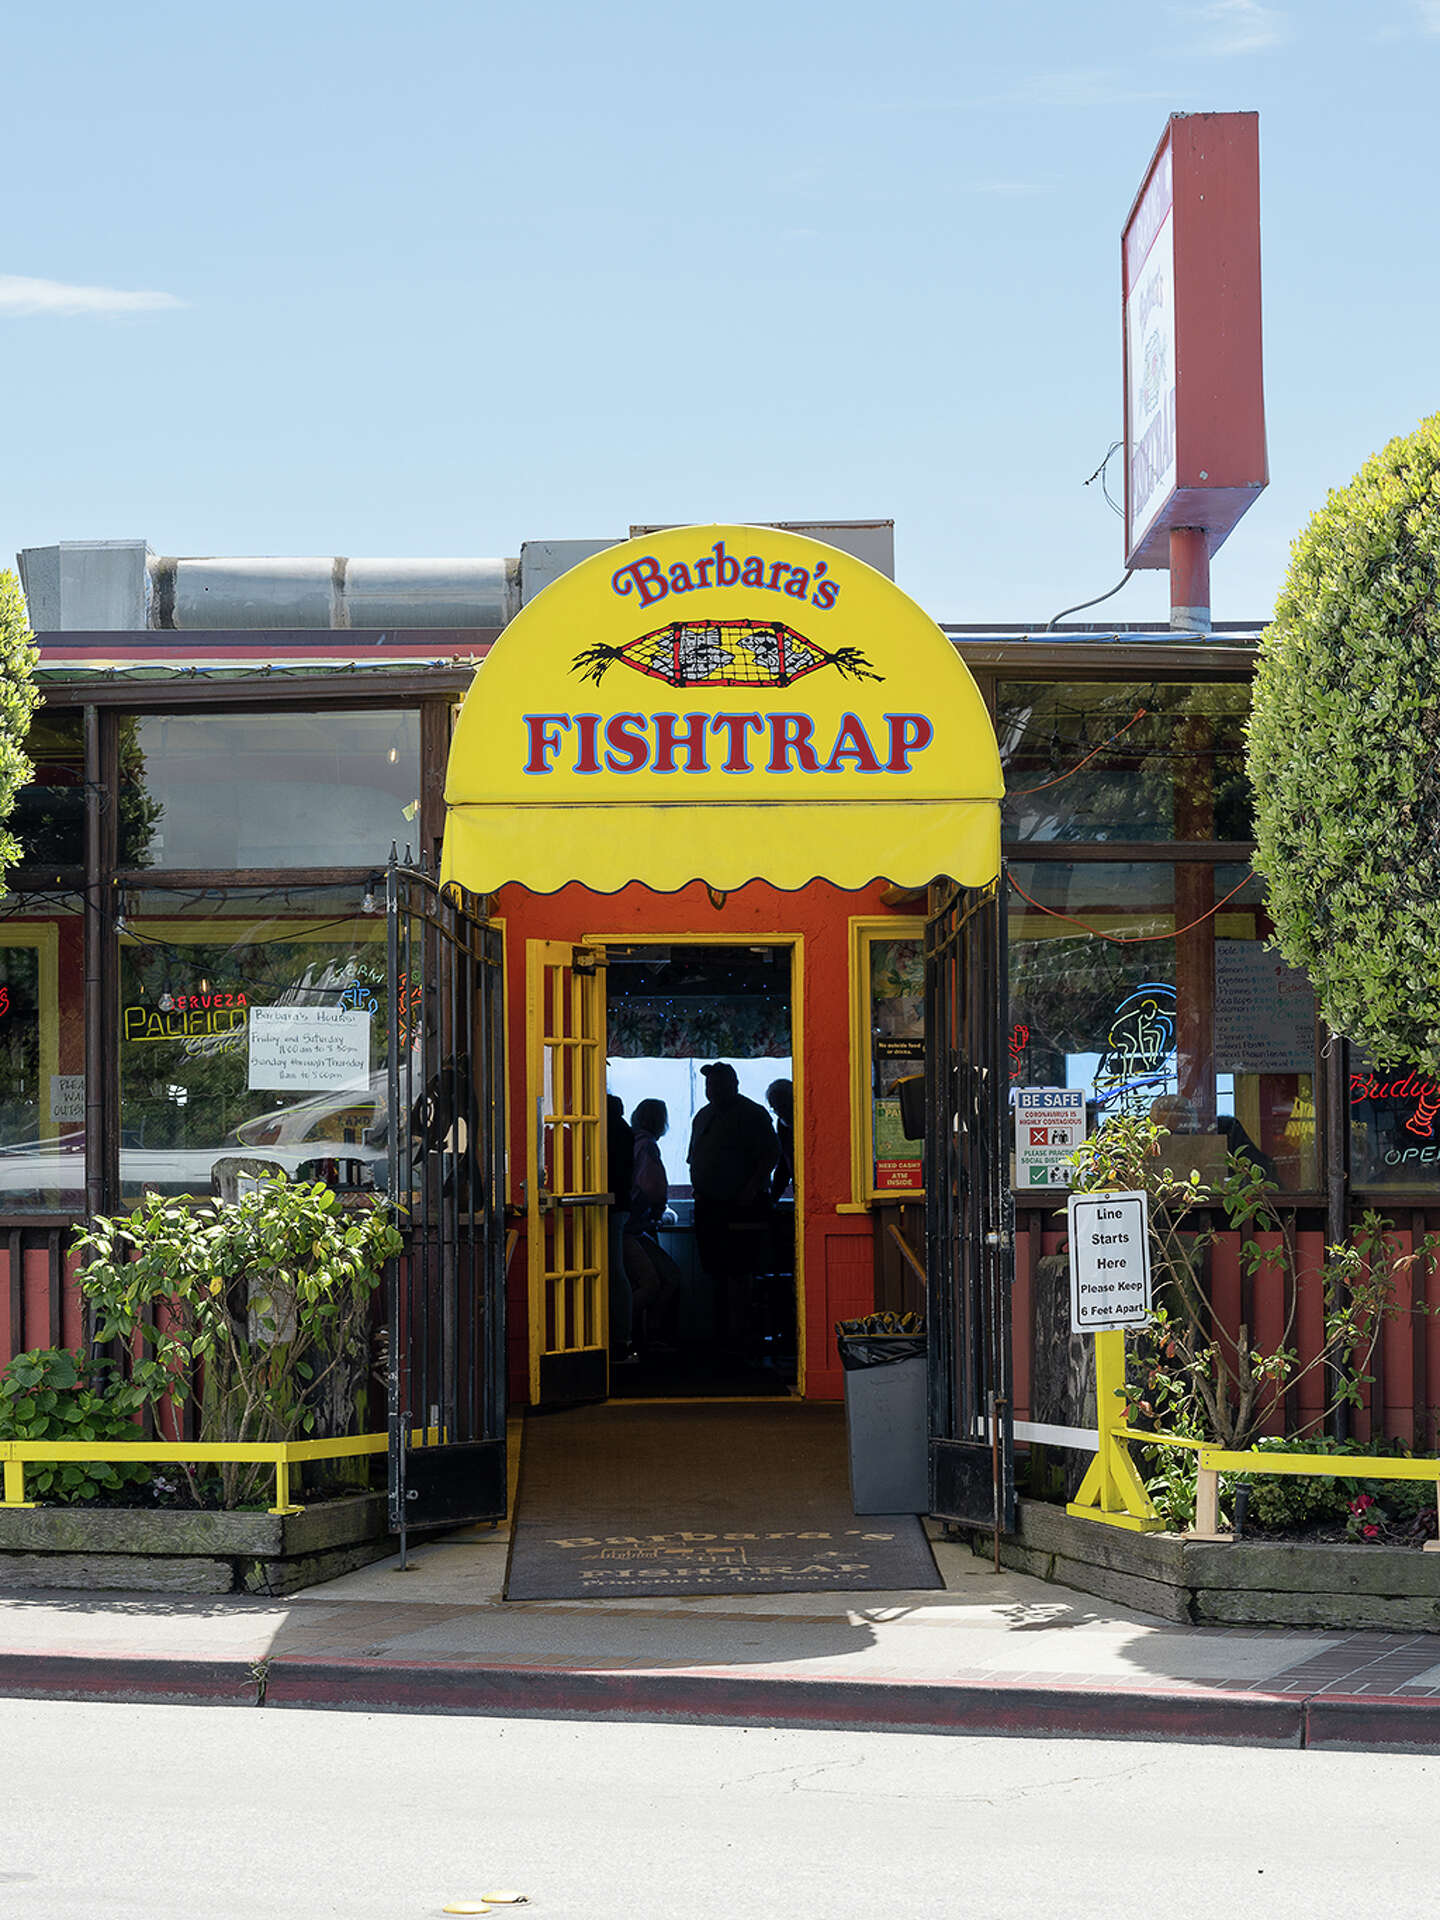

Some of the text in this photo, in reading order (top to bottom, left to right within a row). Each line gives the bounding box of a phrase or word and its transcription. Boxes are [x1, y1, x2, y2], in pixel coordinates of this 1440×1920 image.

[611, 541, 841, 611] Barbara's
[522, 712, 934, 776] FISHTRAP
[124, 1006, 247, 1040] PACIFICO
[59, 1079, 85, 1091] PLEA
[1350, 1068, 1440, 1104] Budw
[64, 1092, 84, 1102] WAI
[1021, 1093, 1080, 1107] BE SAFE
[53, 1103, 84, 1117] OUTSI
[1097, 1208, 1123, 1220] Line
[1091, 1233, 1129, 1245] Starts
[1097, 1258, 1127, 1269] Here
[1080, 1281, 1143, 1294] Please Keep
[1081, 1303, 1144, 1316] 6 Feet Apart
[545, 1530, 896, 1549] Barbara's
